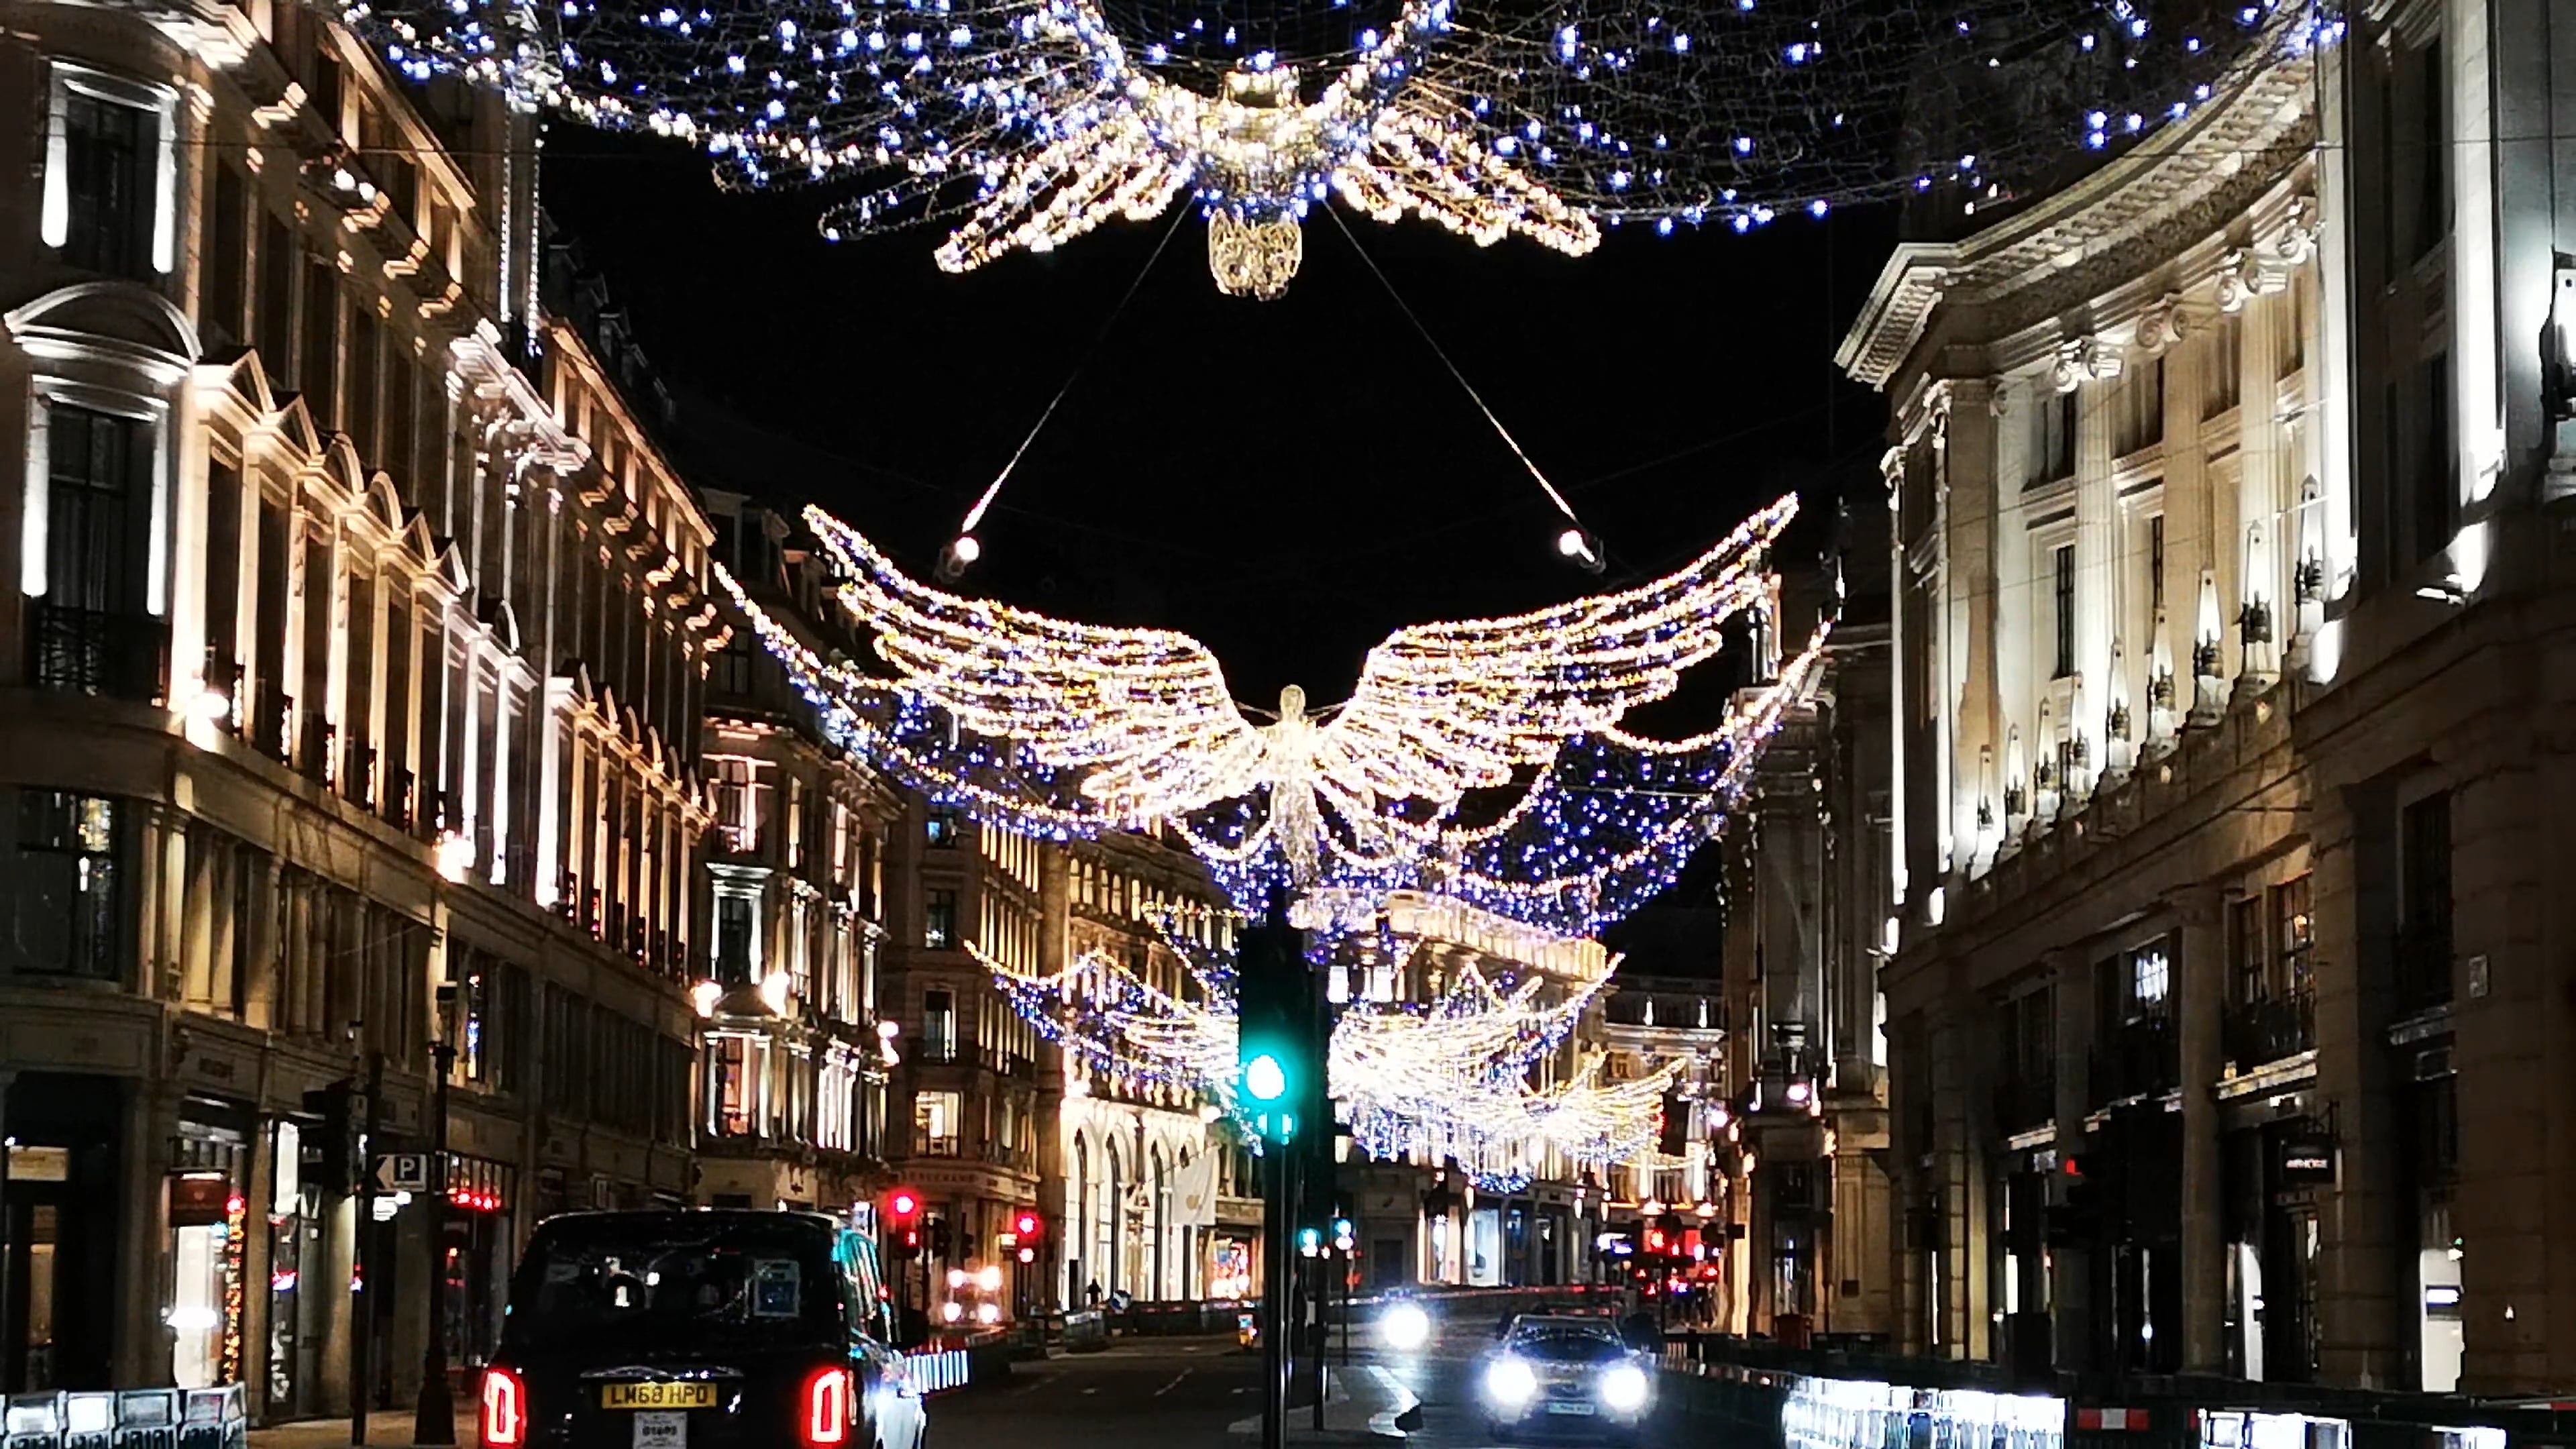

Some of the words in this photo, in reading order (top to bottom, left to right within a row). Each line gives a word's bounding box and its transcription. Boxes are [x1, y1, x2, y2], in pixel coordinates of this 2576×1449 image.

[400, 1158, 415, 1179] P
[610, 1386, 664, 1404] LM68
[668, 1385, 708, 1404] HPO
